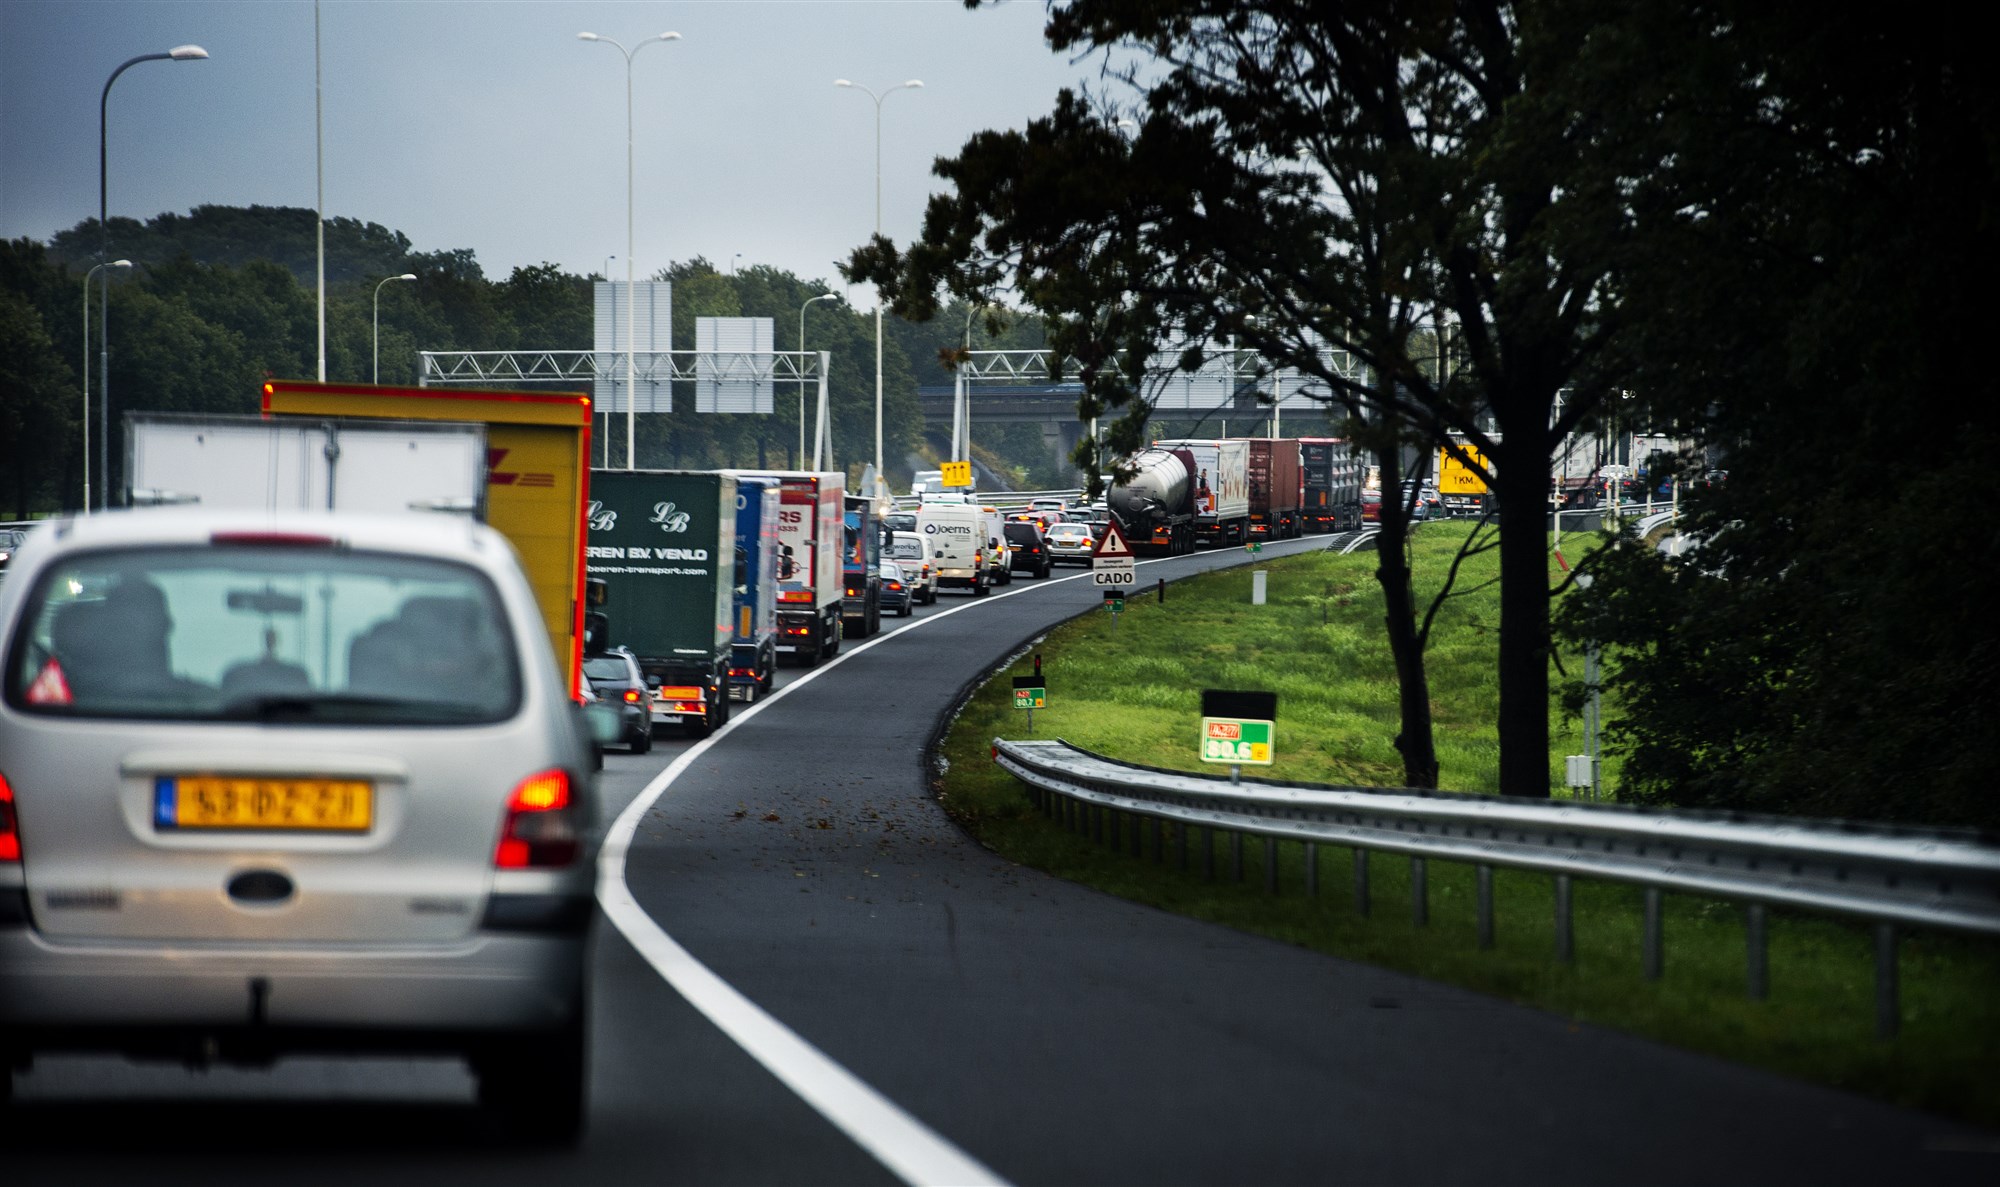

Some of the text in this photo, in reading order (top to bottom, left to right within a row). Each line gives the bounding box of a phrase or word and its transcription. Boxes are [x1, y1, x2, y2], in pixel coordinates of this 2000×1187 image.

[1459, 476, 1474, 484] KM
[653, 548, 709, 561] VENLO
[1095, 572, 1133, 584] CADO
